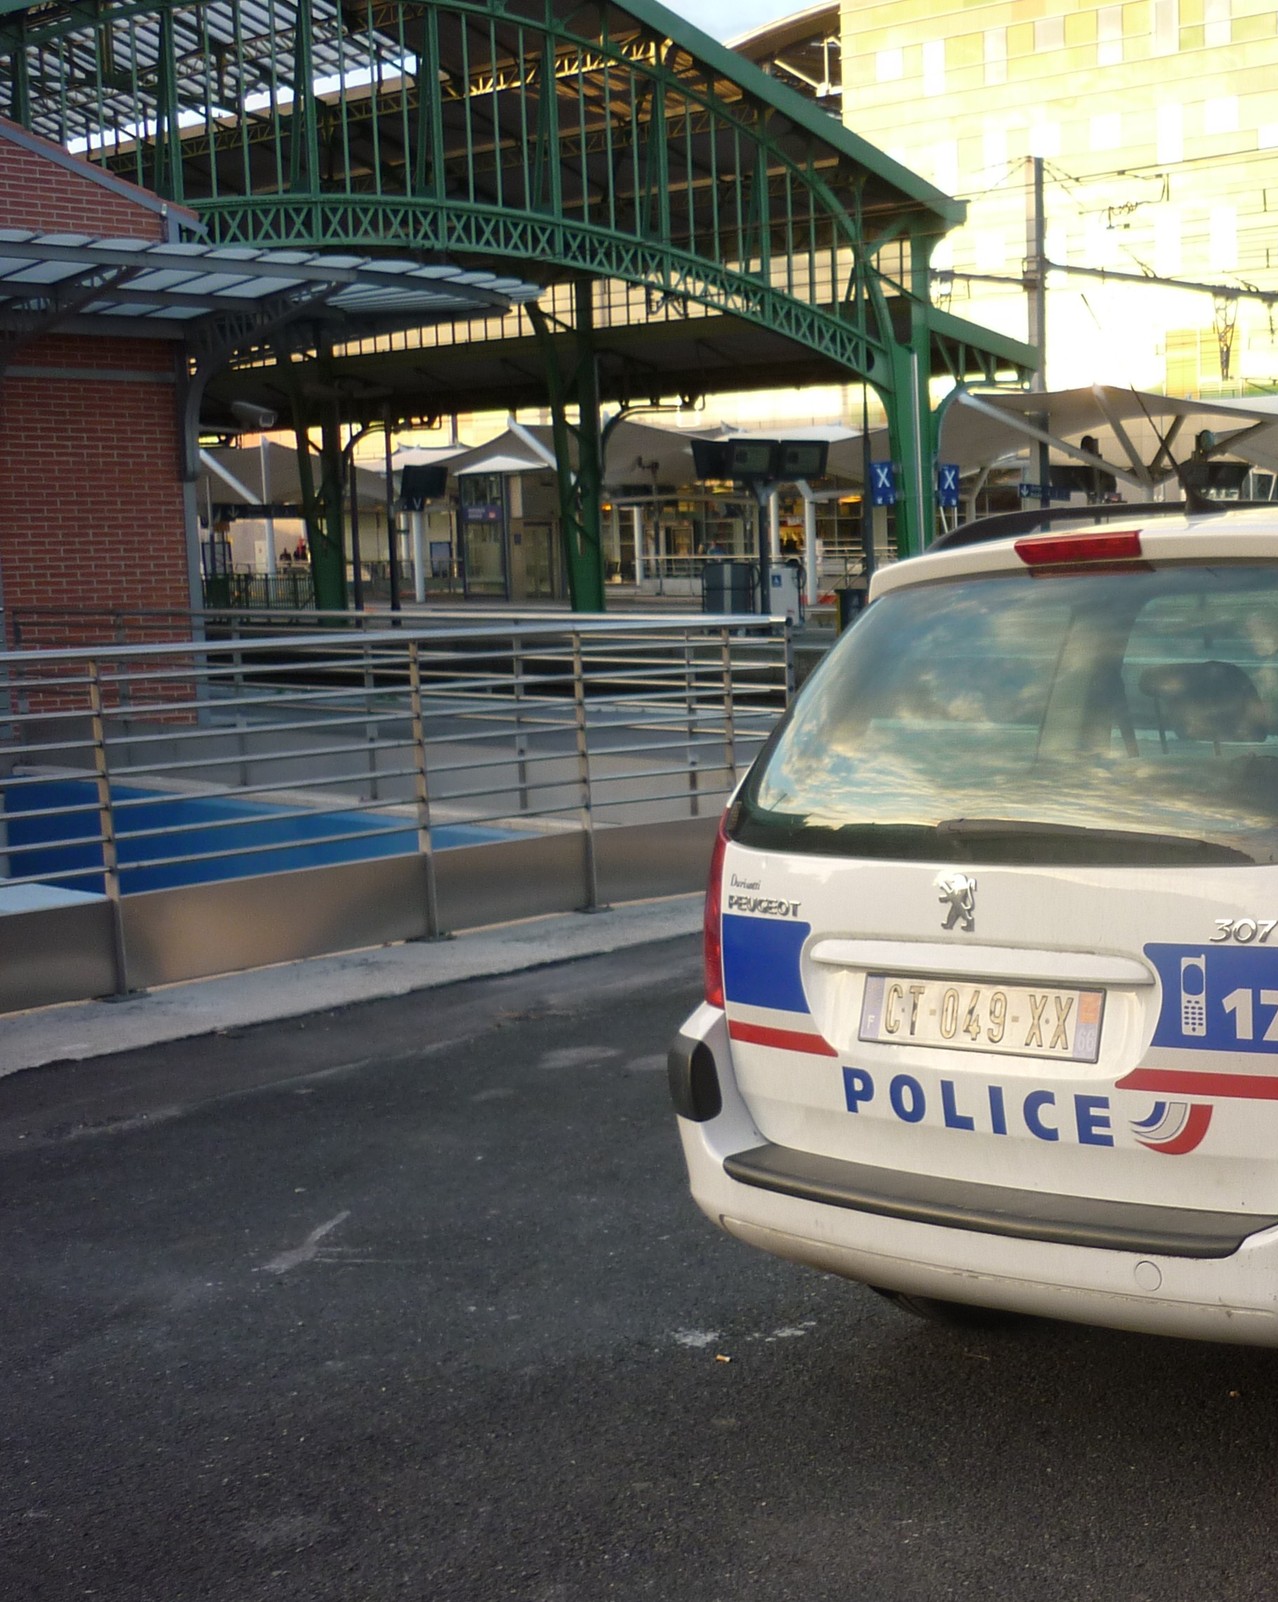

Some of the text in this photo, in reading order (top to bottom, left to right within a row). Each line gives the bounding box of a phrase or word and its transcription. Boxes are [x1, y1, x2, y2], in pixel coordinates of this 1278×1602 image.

[876, 467, 890, 488] X
[944, 470, 955, 489] X
[728, 894, 801, 918] PEUGEOT
[1208, 917, 1278, 944] 307
[866, 1014, 875, 1030] F
[1078, 1030, 1096, 1052] 66
[841, 1065, 1115, 1147] POLICE
